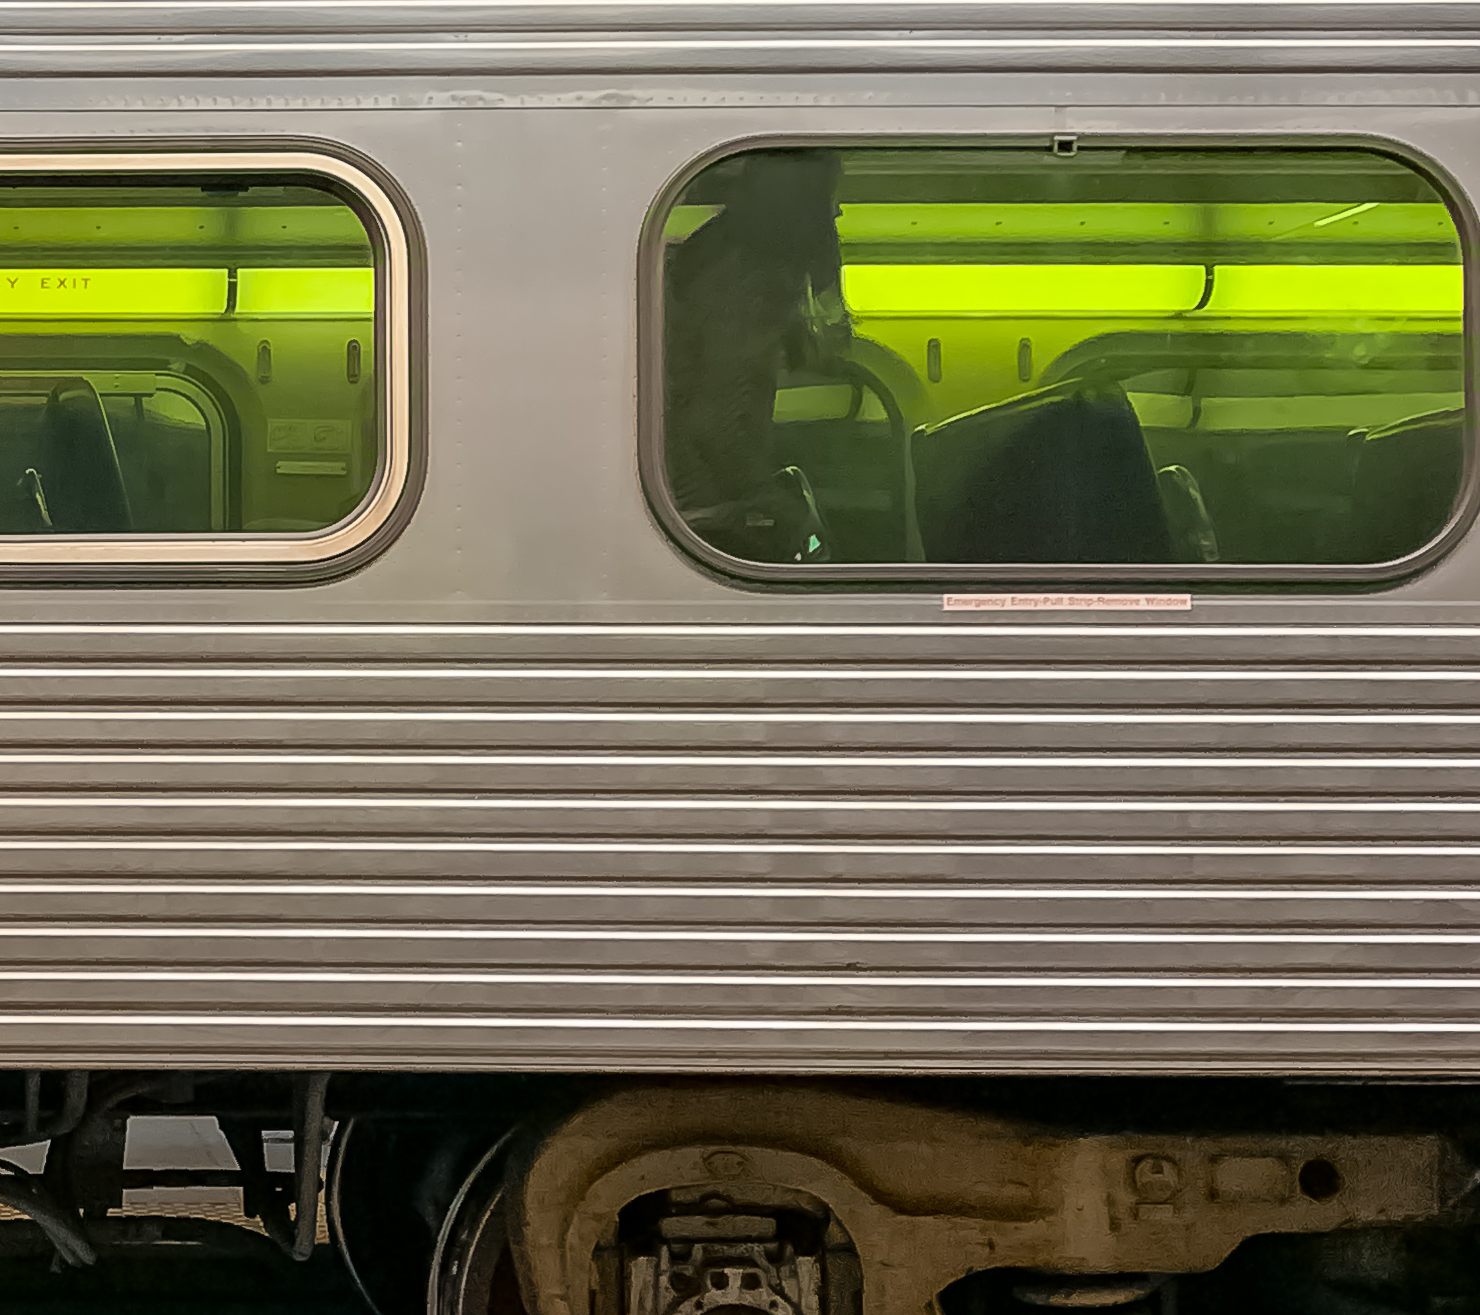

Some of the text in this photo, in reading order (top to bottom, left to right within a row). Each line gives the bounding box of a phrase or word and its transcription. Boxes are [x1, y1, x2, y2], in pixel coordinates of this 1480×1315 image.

[40, 277, 93, 290] EXIT
[946, 596, 1007, 608] Emergency
[1144, 596, 1188, 607] Window
